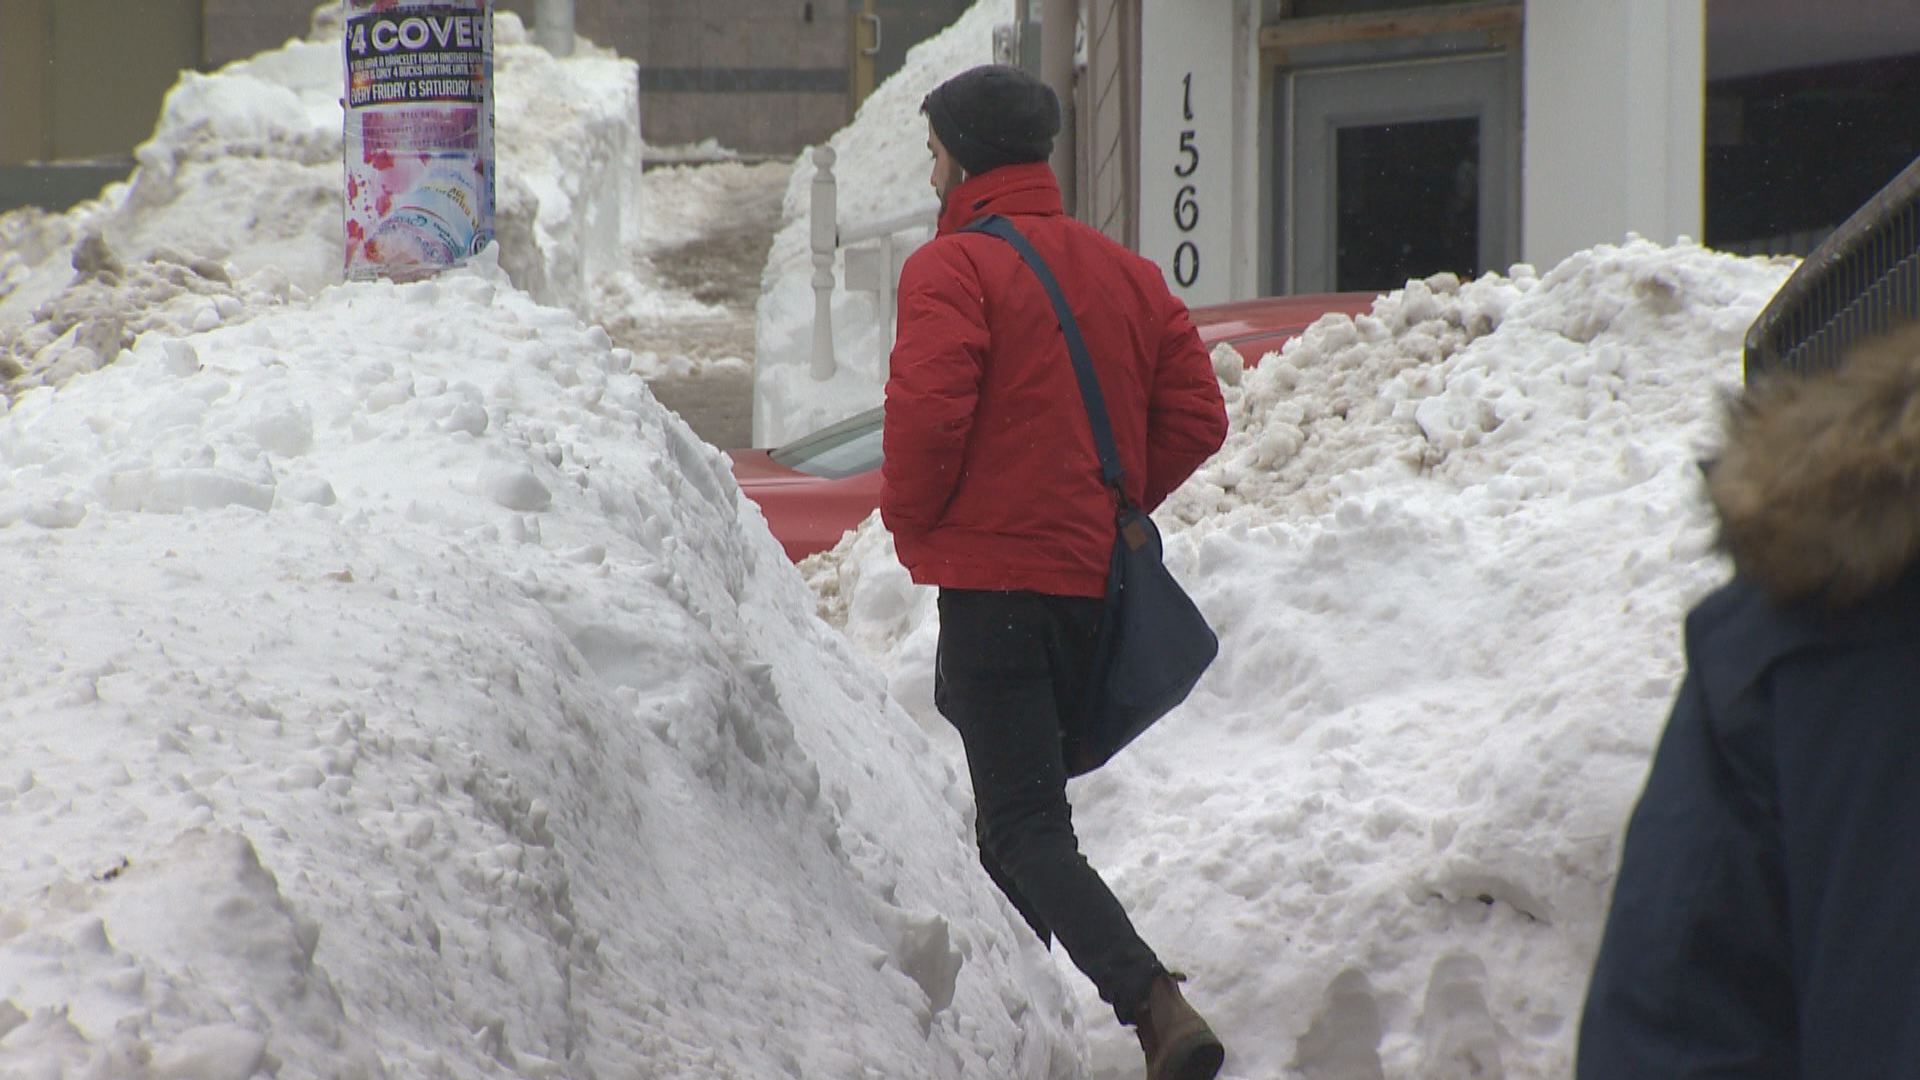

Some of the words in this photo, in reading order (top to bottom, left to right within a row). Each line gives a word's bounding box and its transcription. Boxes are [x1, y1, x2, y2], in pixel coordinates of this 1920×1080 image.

[386, 53, 417, 67] BRACELET
[418, 52, 439, 65] FROM
[439, 51, 468, 64] ANOTHER
[377, 67, 392, 80] ONLY
[399, 66, 422, 78] BUCKS
[424, 64, 452, 76] ANYTIME
[452, 64, 469, 76] UNTIL
[372, 82, 407, 101] FRIDAY
[409, 80, 417, 98] &
[418, 79, 470, 97] SATURDAY
[1173, 71, 1200, 289] 1560
